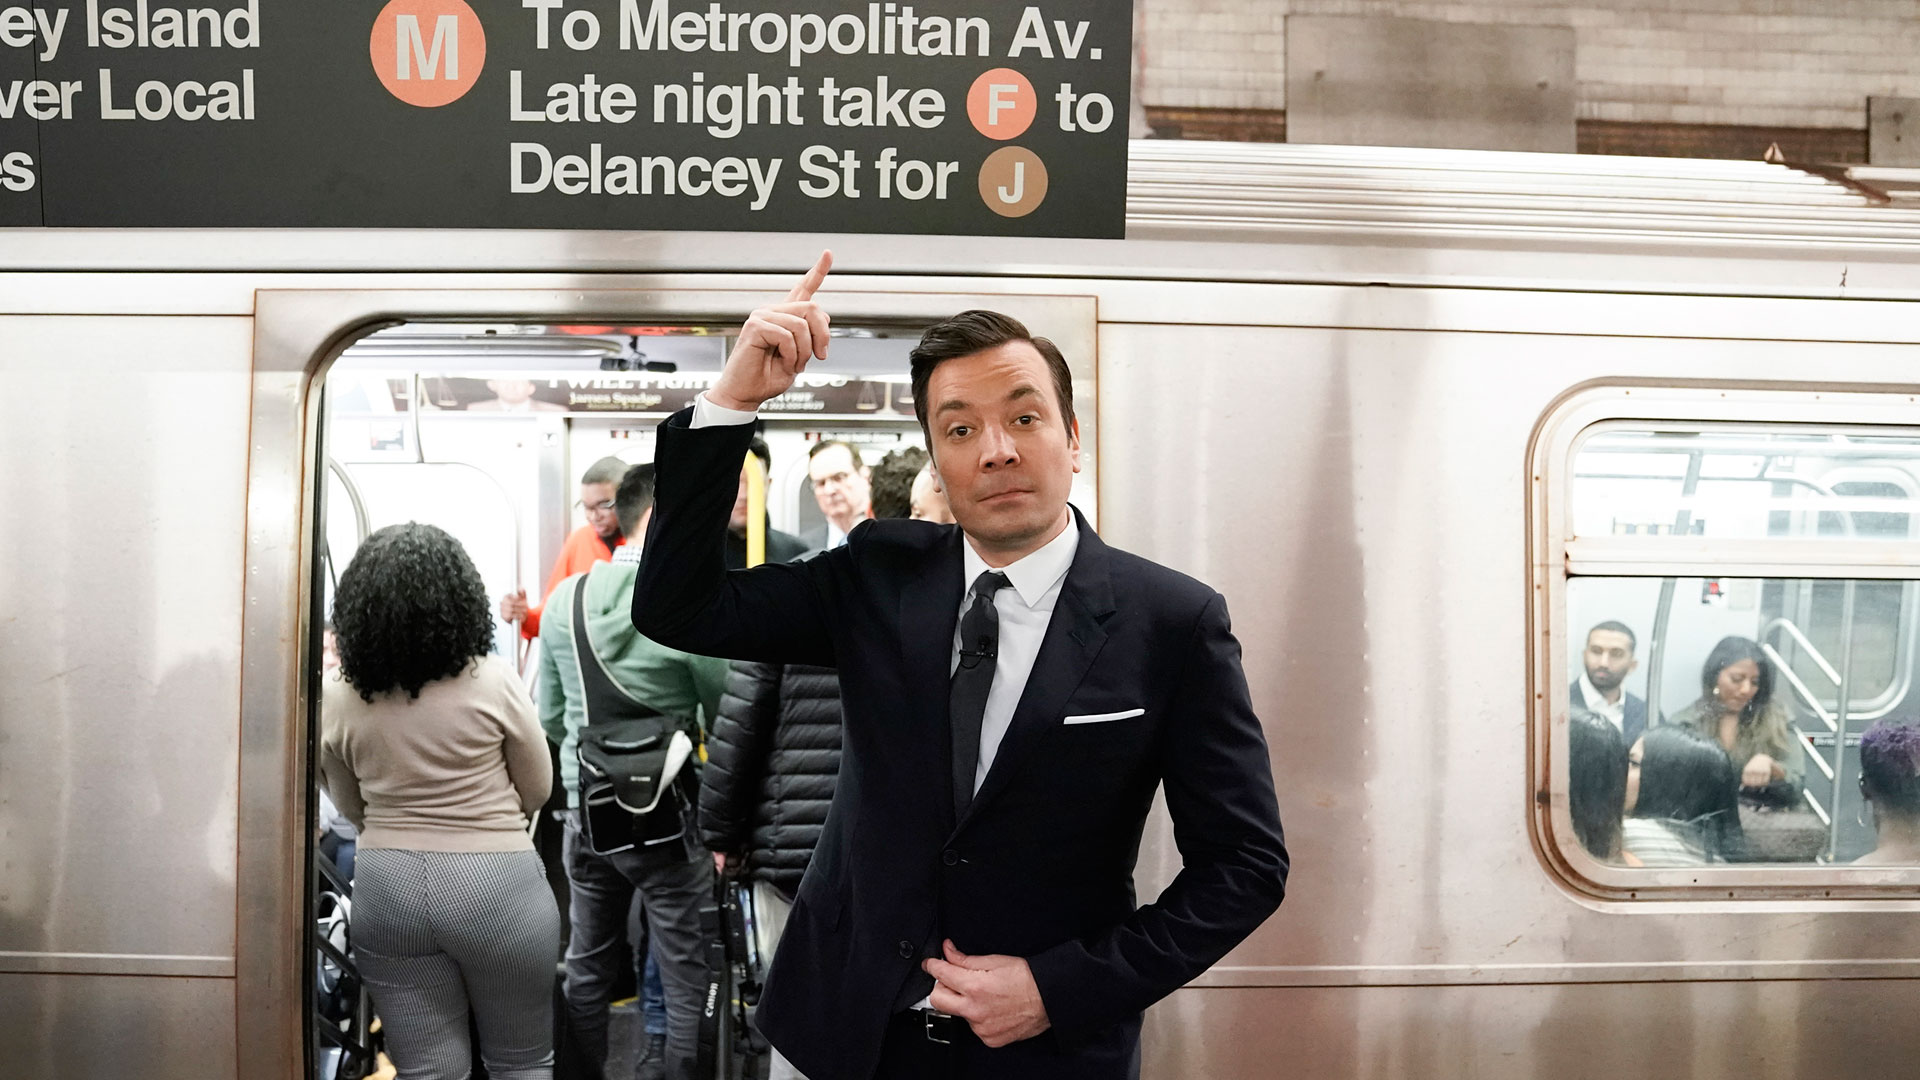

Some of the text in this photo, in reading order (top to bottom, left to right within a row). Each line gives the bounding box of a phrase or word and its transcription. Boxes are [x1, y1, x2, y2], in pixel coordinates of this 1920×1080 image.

[86, 0, 260, 48] Island
[396, 14, 459, 81] M
[522, 0, 1102, 67] To Metropolitan Av.
[99, 68, 255, 121] Local
[510, 70, 1114, 139] Late night take F to
[0, 151, 35, 192] s
[510, 142, 1025, 211] Delancey St for J
[705, 982, 719, 1018] Canon
